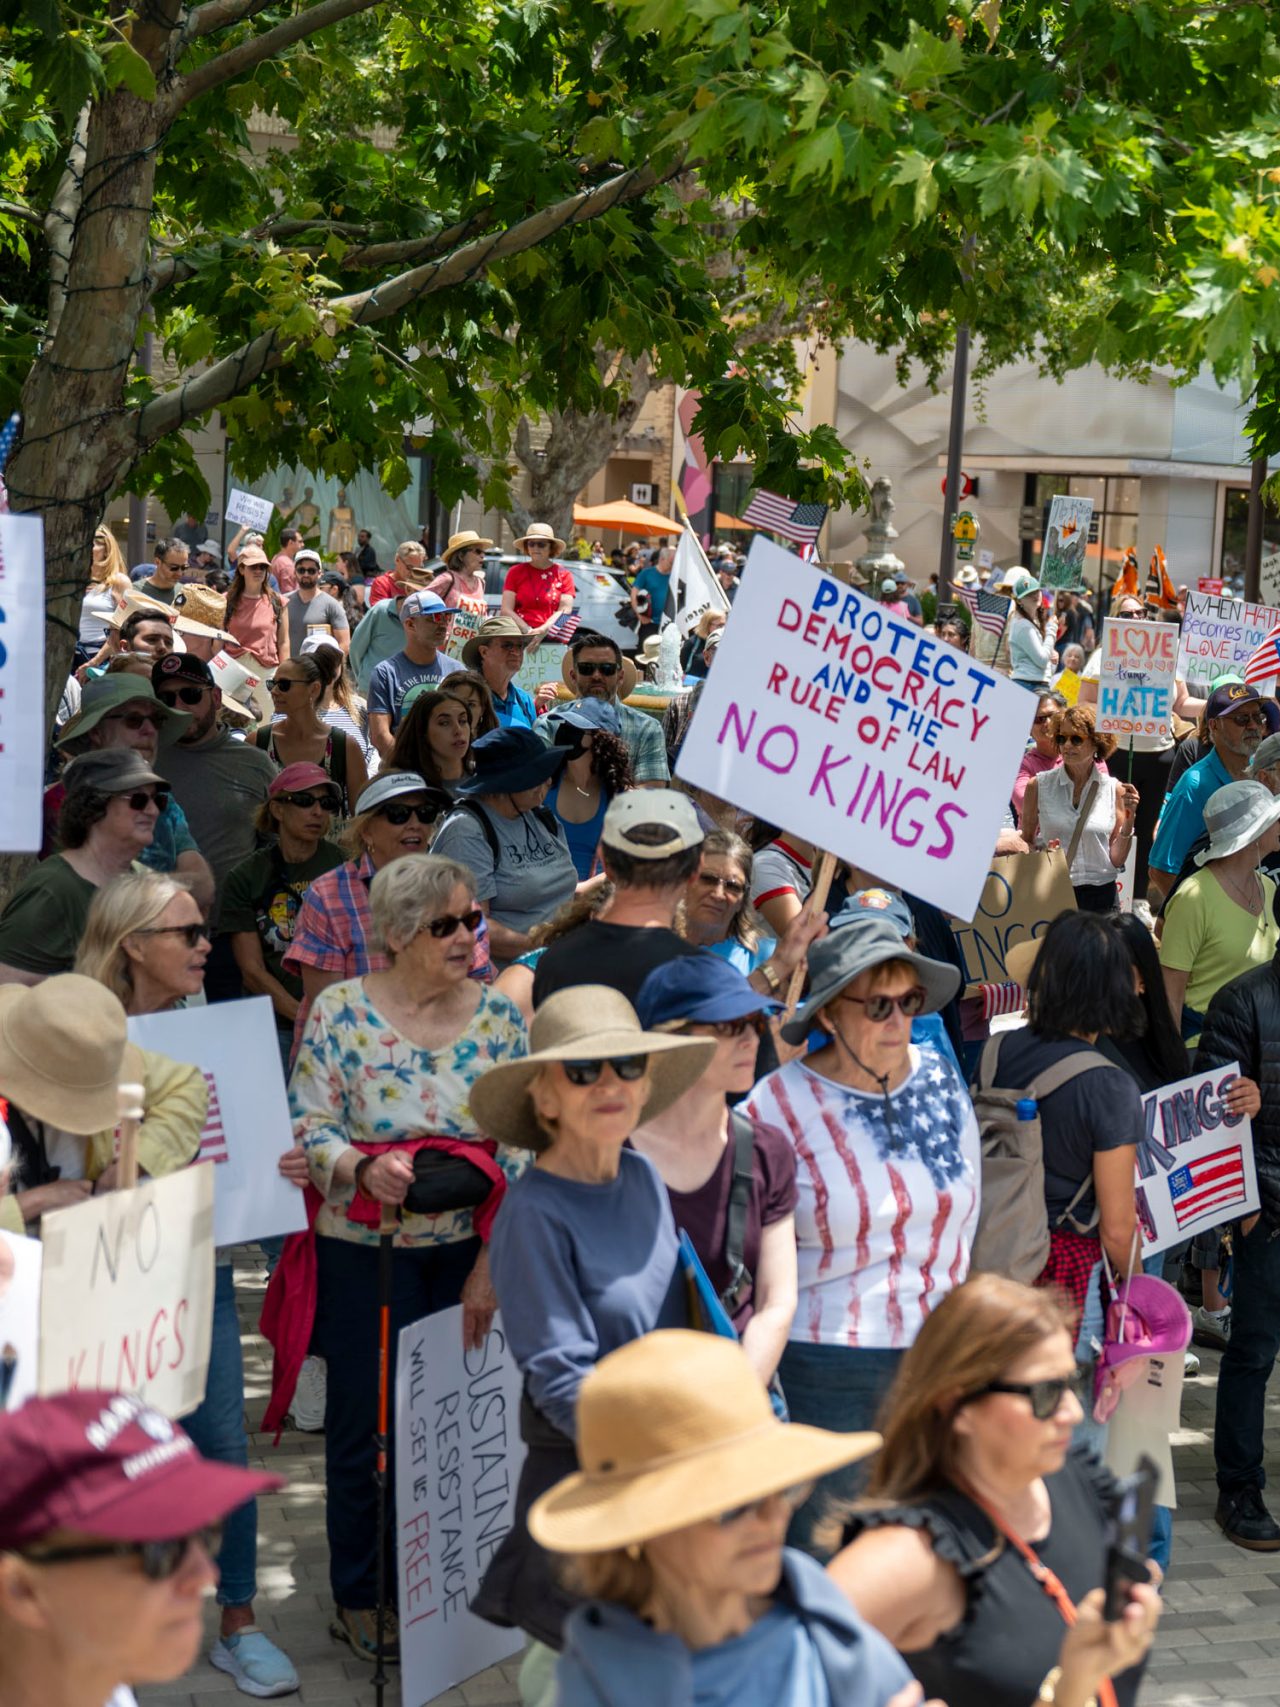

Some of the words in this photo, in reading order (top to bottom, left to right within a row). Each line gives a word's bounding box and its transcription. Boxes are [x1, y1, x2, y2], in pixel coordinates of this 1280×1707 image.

[1183, 612, 1242, 641] Becomes
[1185, 591, 1241, 621] WHEN
[453, 626, 477, 640] GRE
[526, 647, 562, 665] NDS
[811, 578, 996, 705] PROTECT
[1109, 628, 1174, 658] LOVE
[1186, 635, 1231, 659] LOVE
[518, 667, 545, 679] OFF
[776, 598, 990, 742] DEMOCRACY
[1115, 664, 1150, 685] trumps
[1229, 685, 1249, 700] Cal
[767, 662, 846, 723] RULE
[857, 715, 901, 752] OF
[907, 742, 966, 790] LAW
[812, 663, 871, 704] AND
[887, 697, 943, 748] THE
[1102, 686, 1169, 717] HATE
[716, 702, 799, 775] NO
[809, 744, 968, 860] KINGS
[978, 871, 1012, 918] O
[1136, 1073, 1244, 1180] KINGS
[90, 1202, 160, 1290] NO
[67, 1298, 187, 1394] KINGS
[409, 1338, 427, 1411] WILL
[409, 1417, 428, 1470] SET
[464, 1328, 511, 1585] SUSTAINE
[403, 1510, 438, 1629] FREE!
